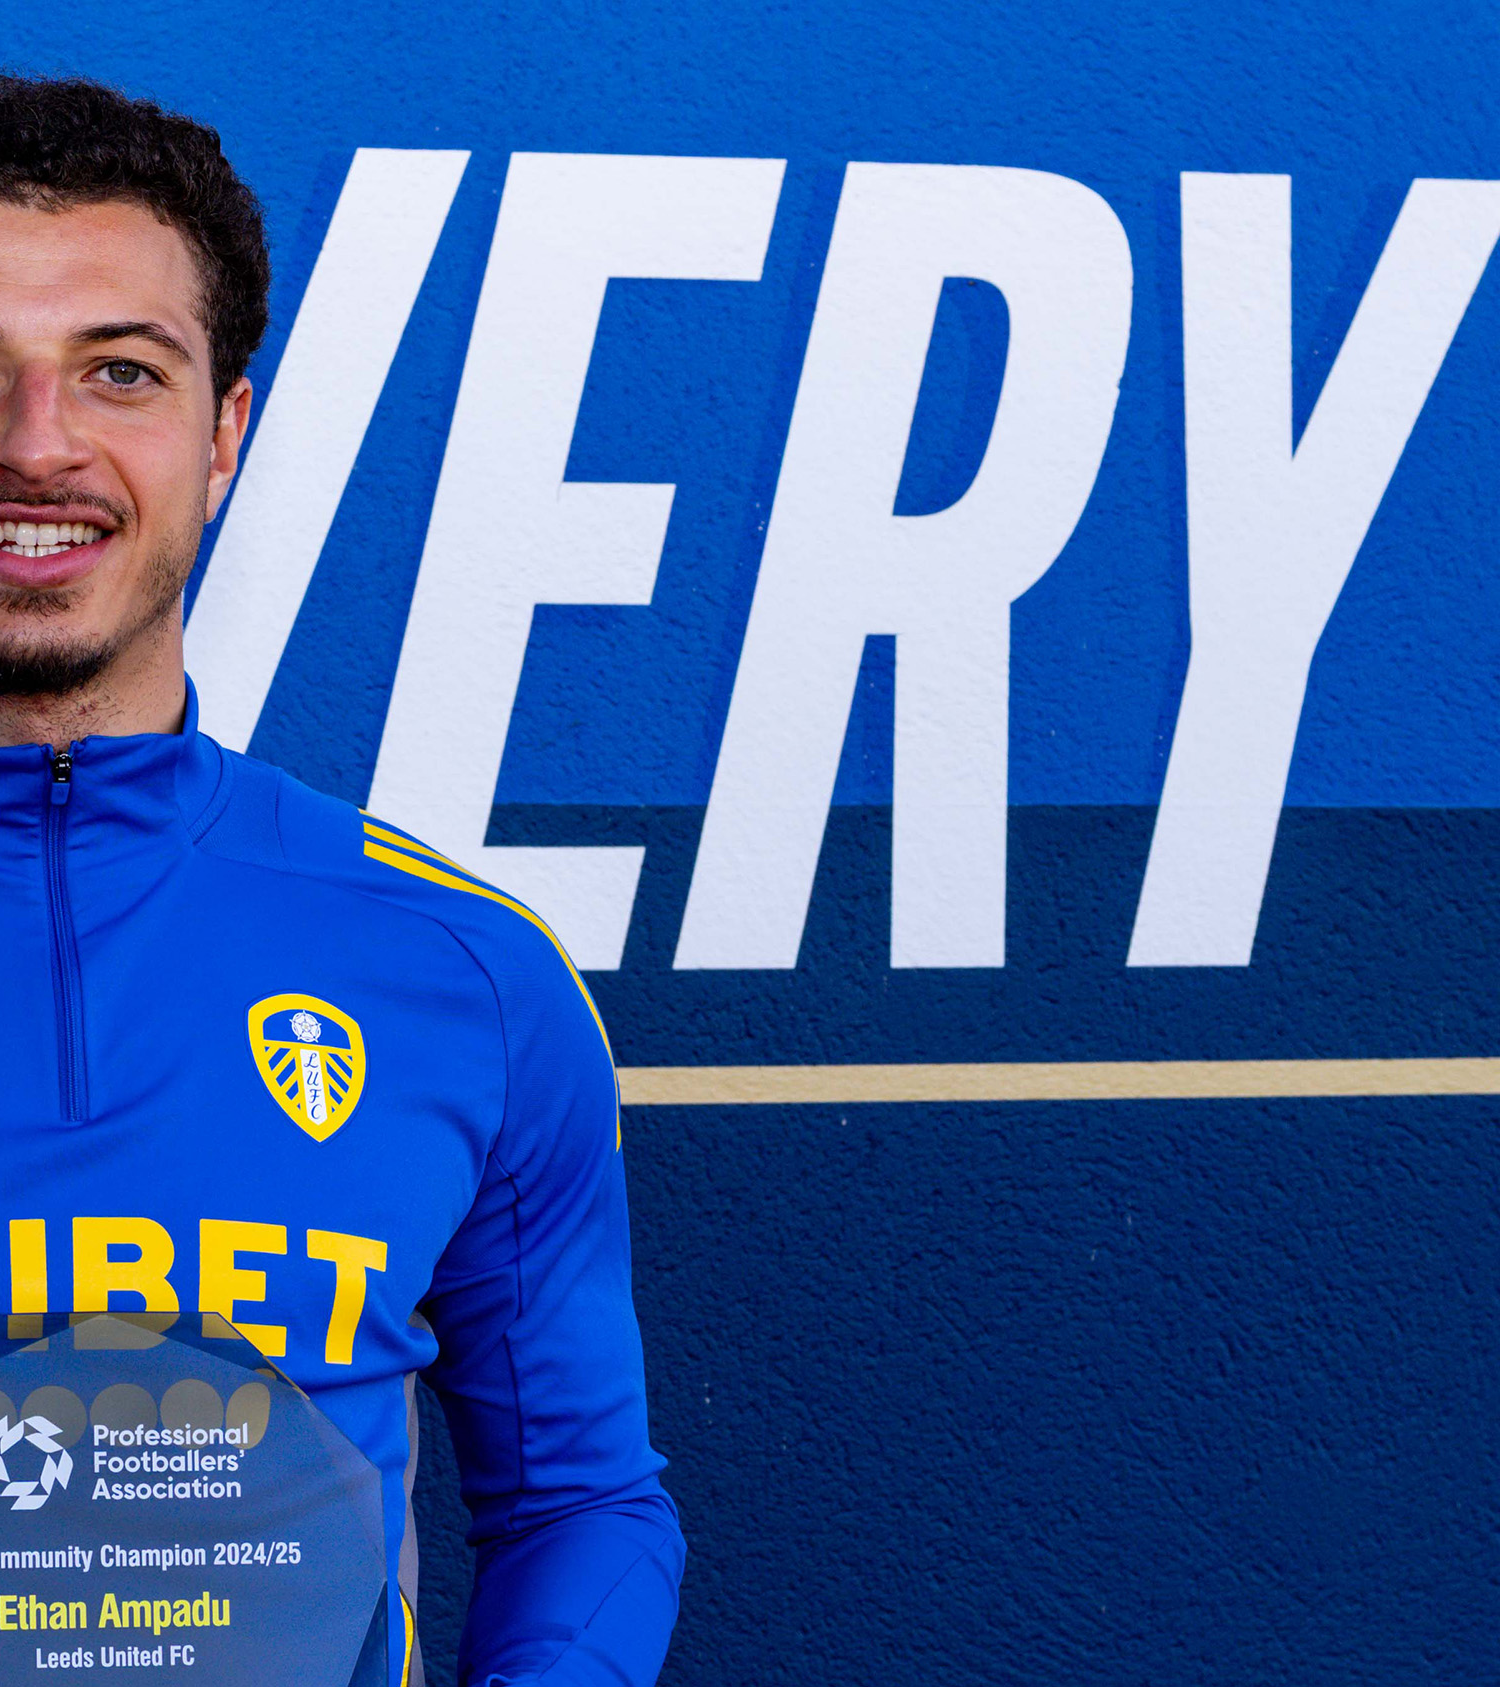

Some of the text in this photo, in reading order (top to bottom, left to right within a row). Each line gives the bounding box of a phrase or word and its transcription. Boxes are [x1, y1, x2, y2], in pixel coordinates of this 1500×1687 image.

[303, 1052, 323, 1120] LUFC
[93, 1422, 249, 1446] Professional
[91, 1475, 242, 1500] Association
[100, 1543, 206, 1571] Champion
[213, 1541, 301, 1567] 2024/25
[98, 1591, 231, 1636] Ampadu
[35, 1644, 196, 1669] Leeds United FC
